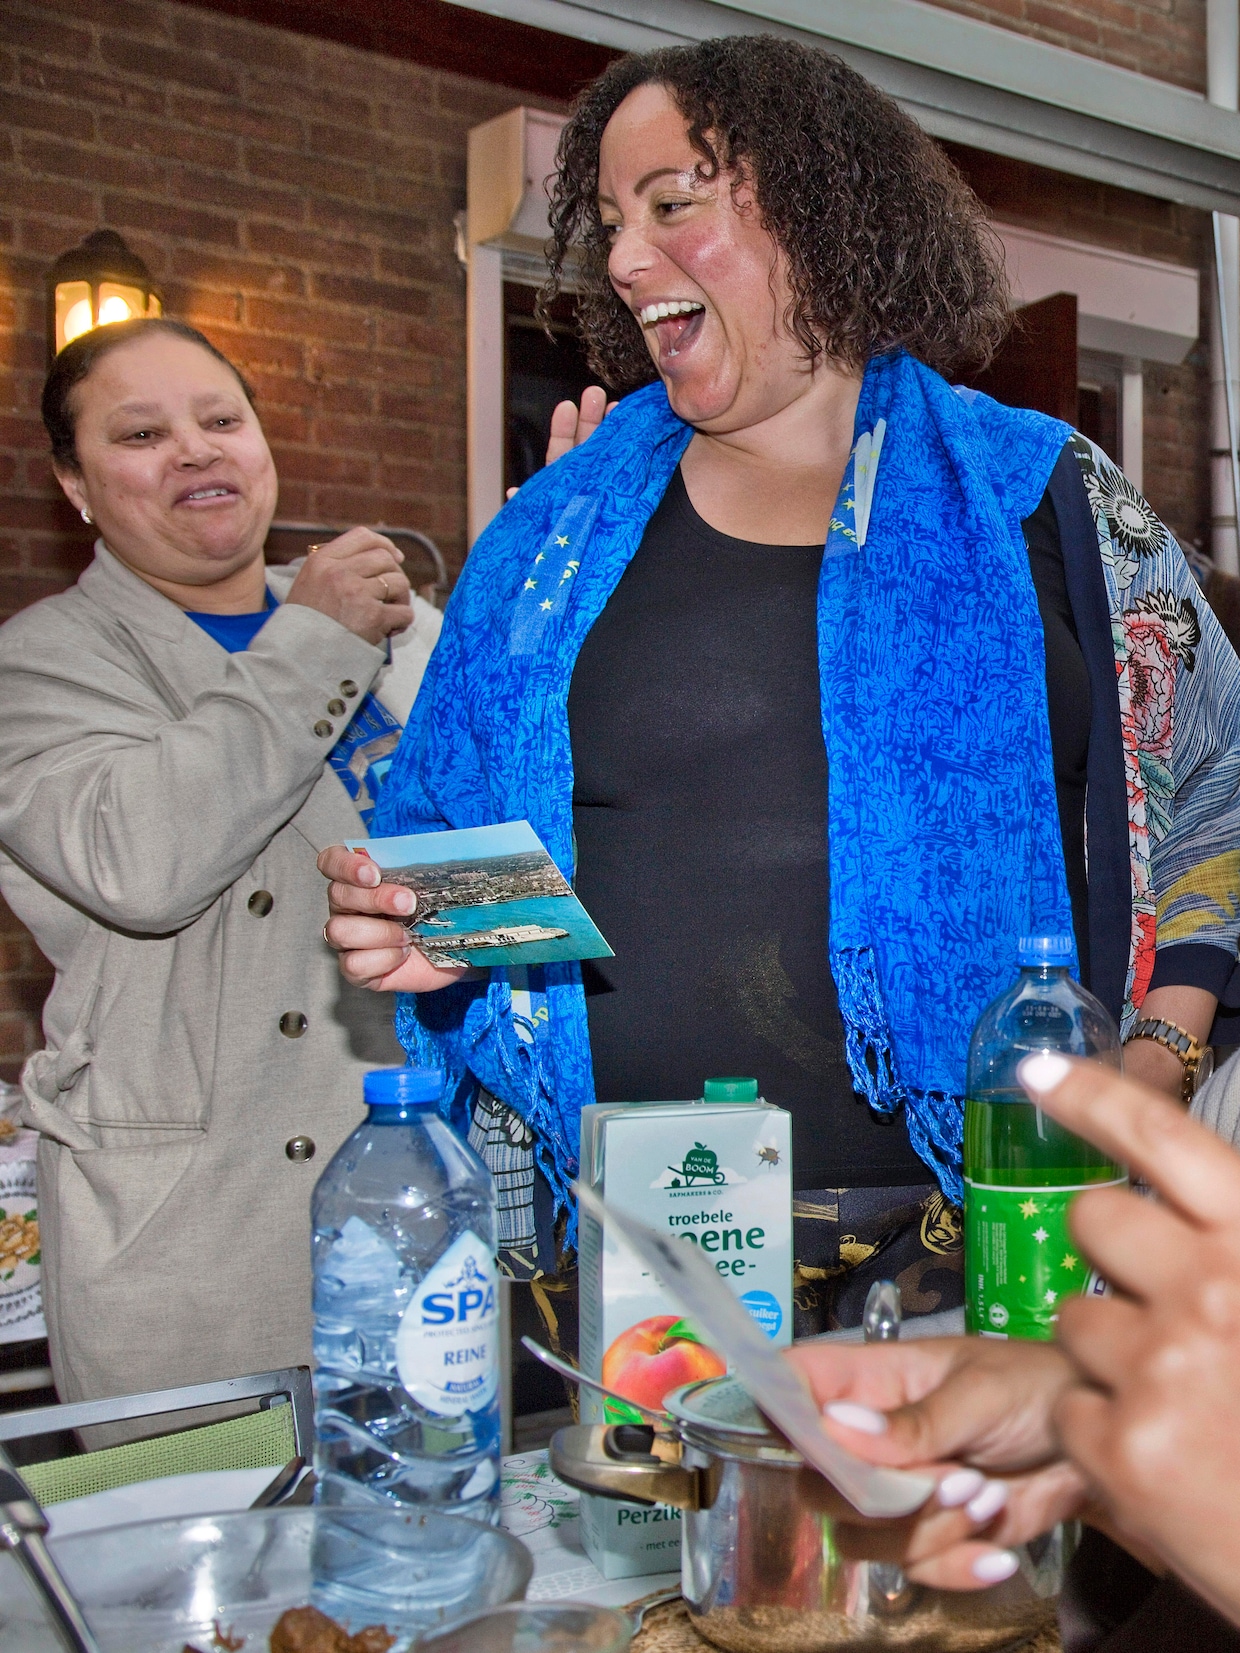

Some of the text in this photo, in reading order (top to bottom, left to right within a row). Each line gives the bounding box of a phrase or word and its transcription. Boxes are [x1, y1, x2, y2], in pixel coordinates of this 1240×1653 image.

[685, 1163, 714, 1174] BOOM
[668, 1209, 733, 1226] troebele
[422, 1285, 496, 1325] SPA
[444, 1343, 487, 1366] REINE
[646, 1541, 666, 1551] met
